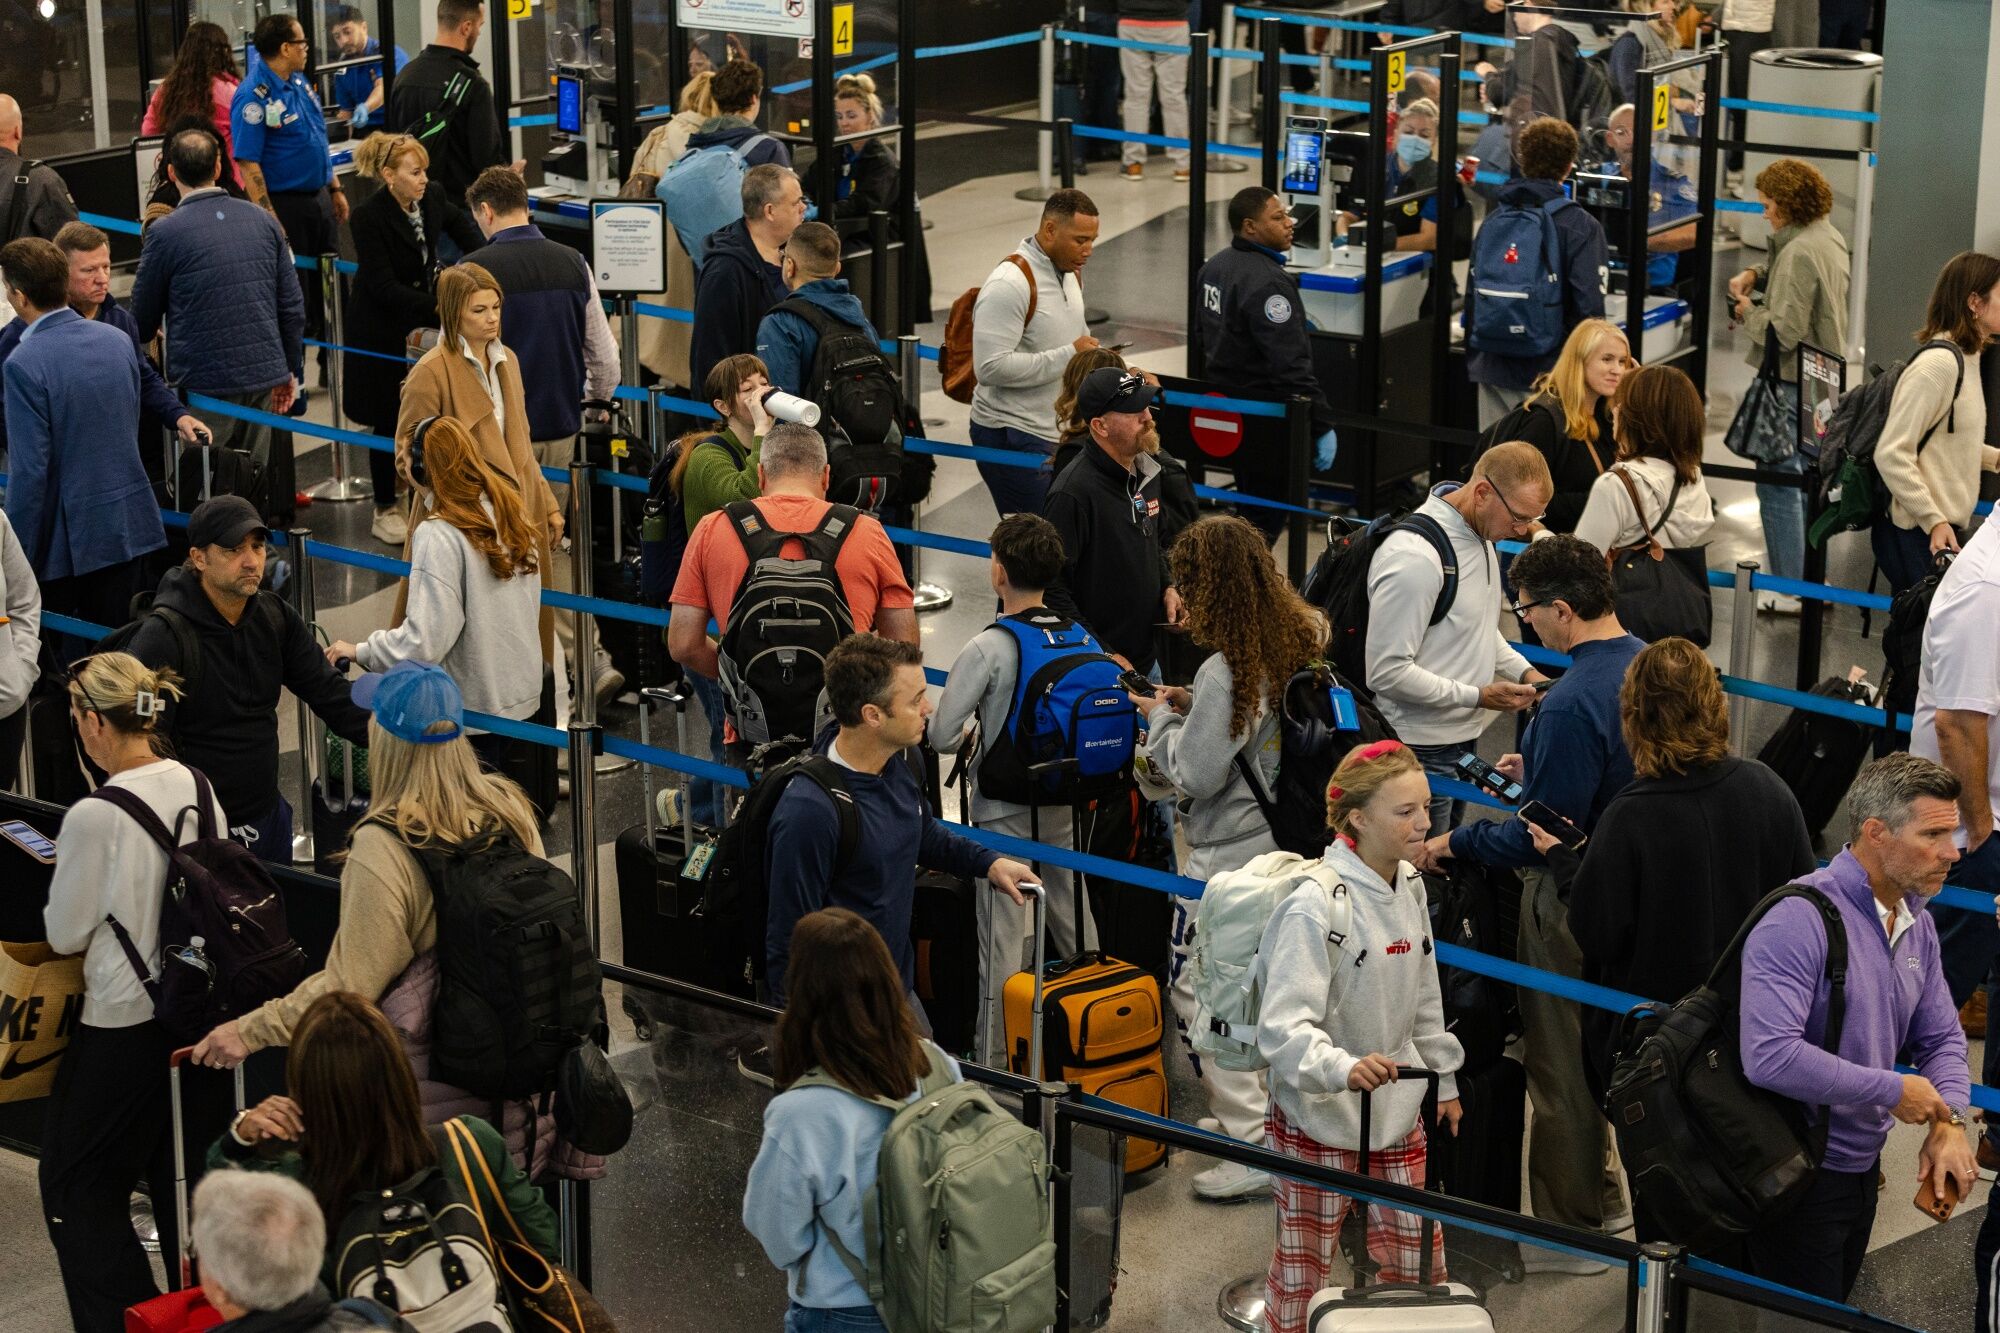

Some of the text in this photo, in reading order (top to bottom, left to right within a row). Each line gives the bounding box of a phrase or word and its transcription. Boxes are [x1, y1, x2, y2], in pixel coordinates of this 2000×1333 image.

[837, 20, 849, 49] 4
[1391, 55, 1401, 89] 3
[1657, 90, 1666, 126] 2
[1094, 698, 1119, 706] OGIO
[0, 990, 45, 1042] KE
